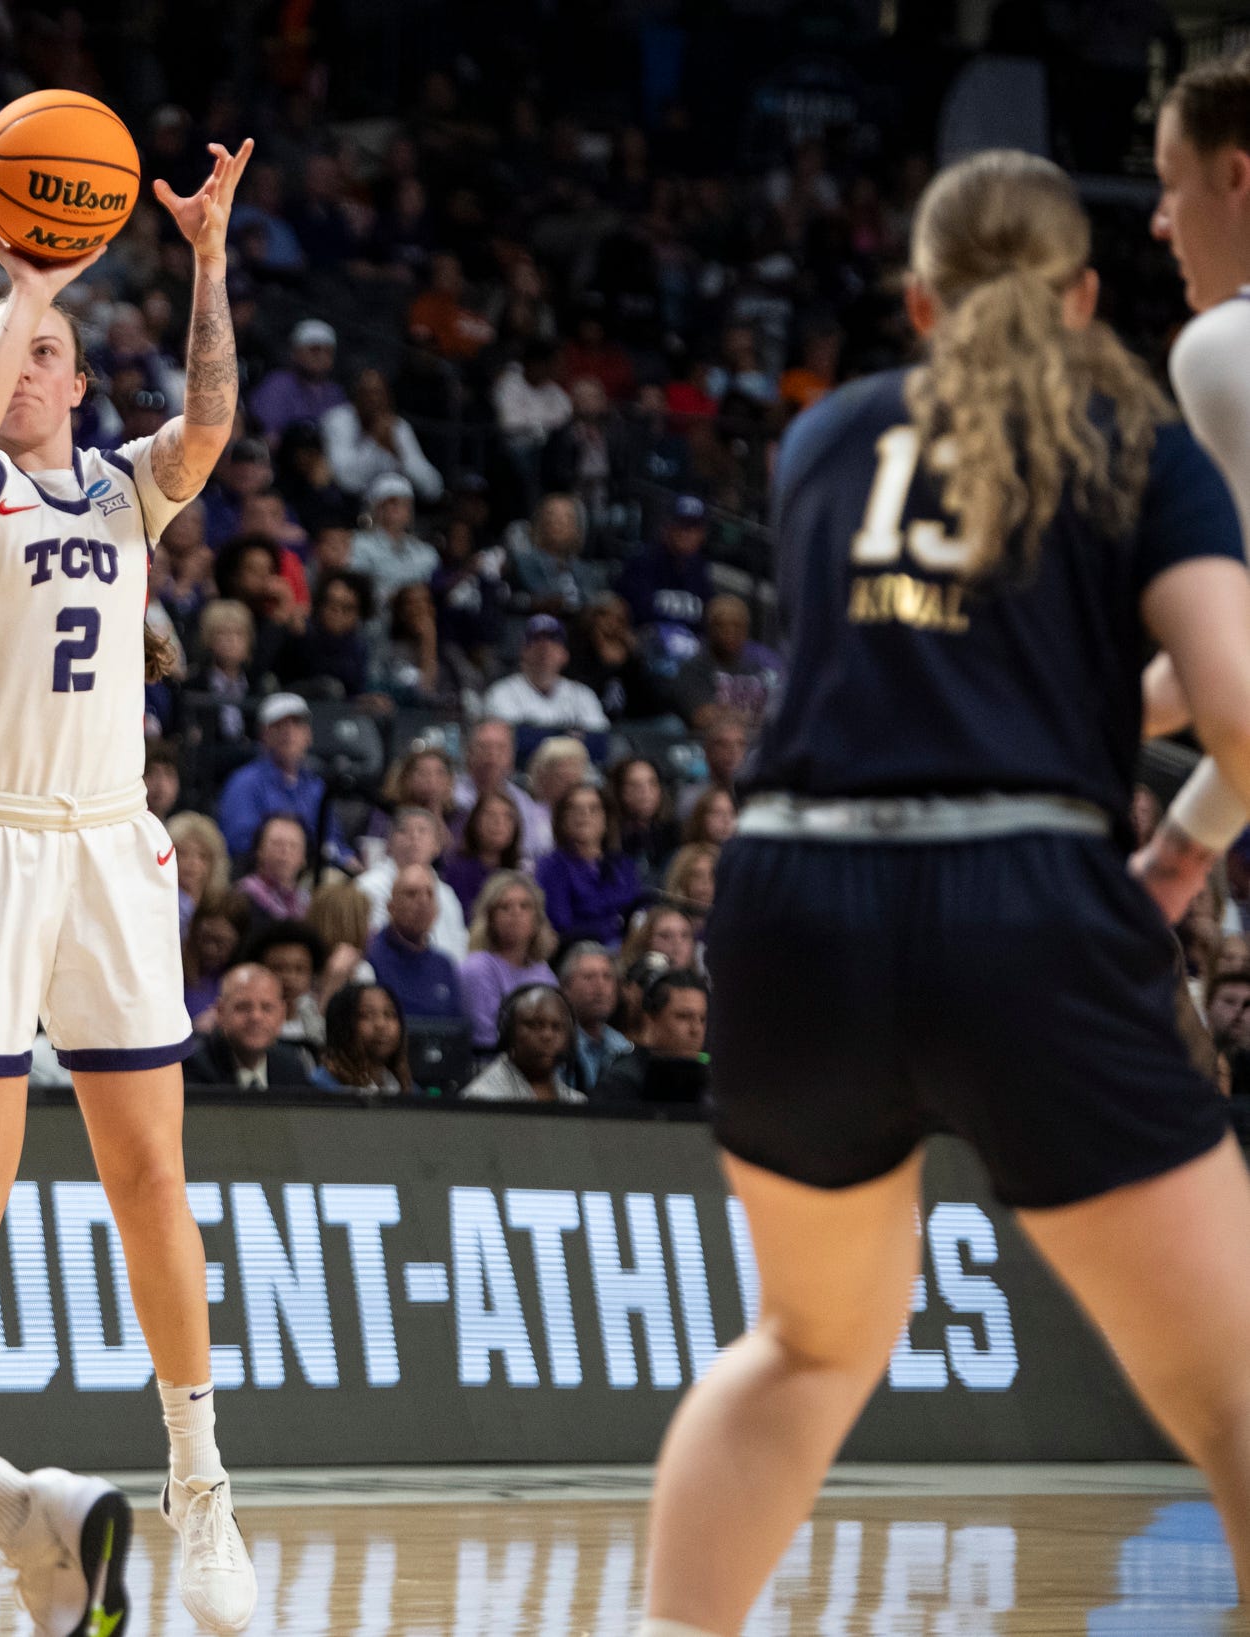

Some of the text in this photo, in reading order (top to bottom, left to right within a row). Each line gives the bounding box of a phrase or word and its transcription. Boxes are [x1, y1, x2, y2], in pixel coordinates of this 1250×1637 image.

[28, 169, 128, 211] Wilson
[25, 225, 106, 250] NCAA
[24, 537, 119, 587] TCU
[52, 607, 101, 692] 2
